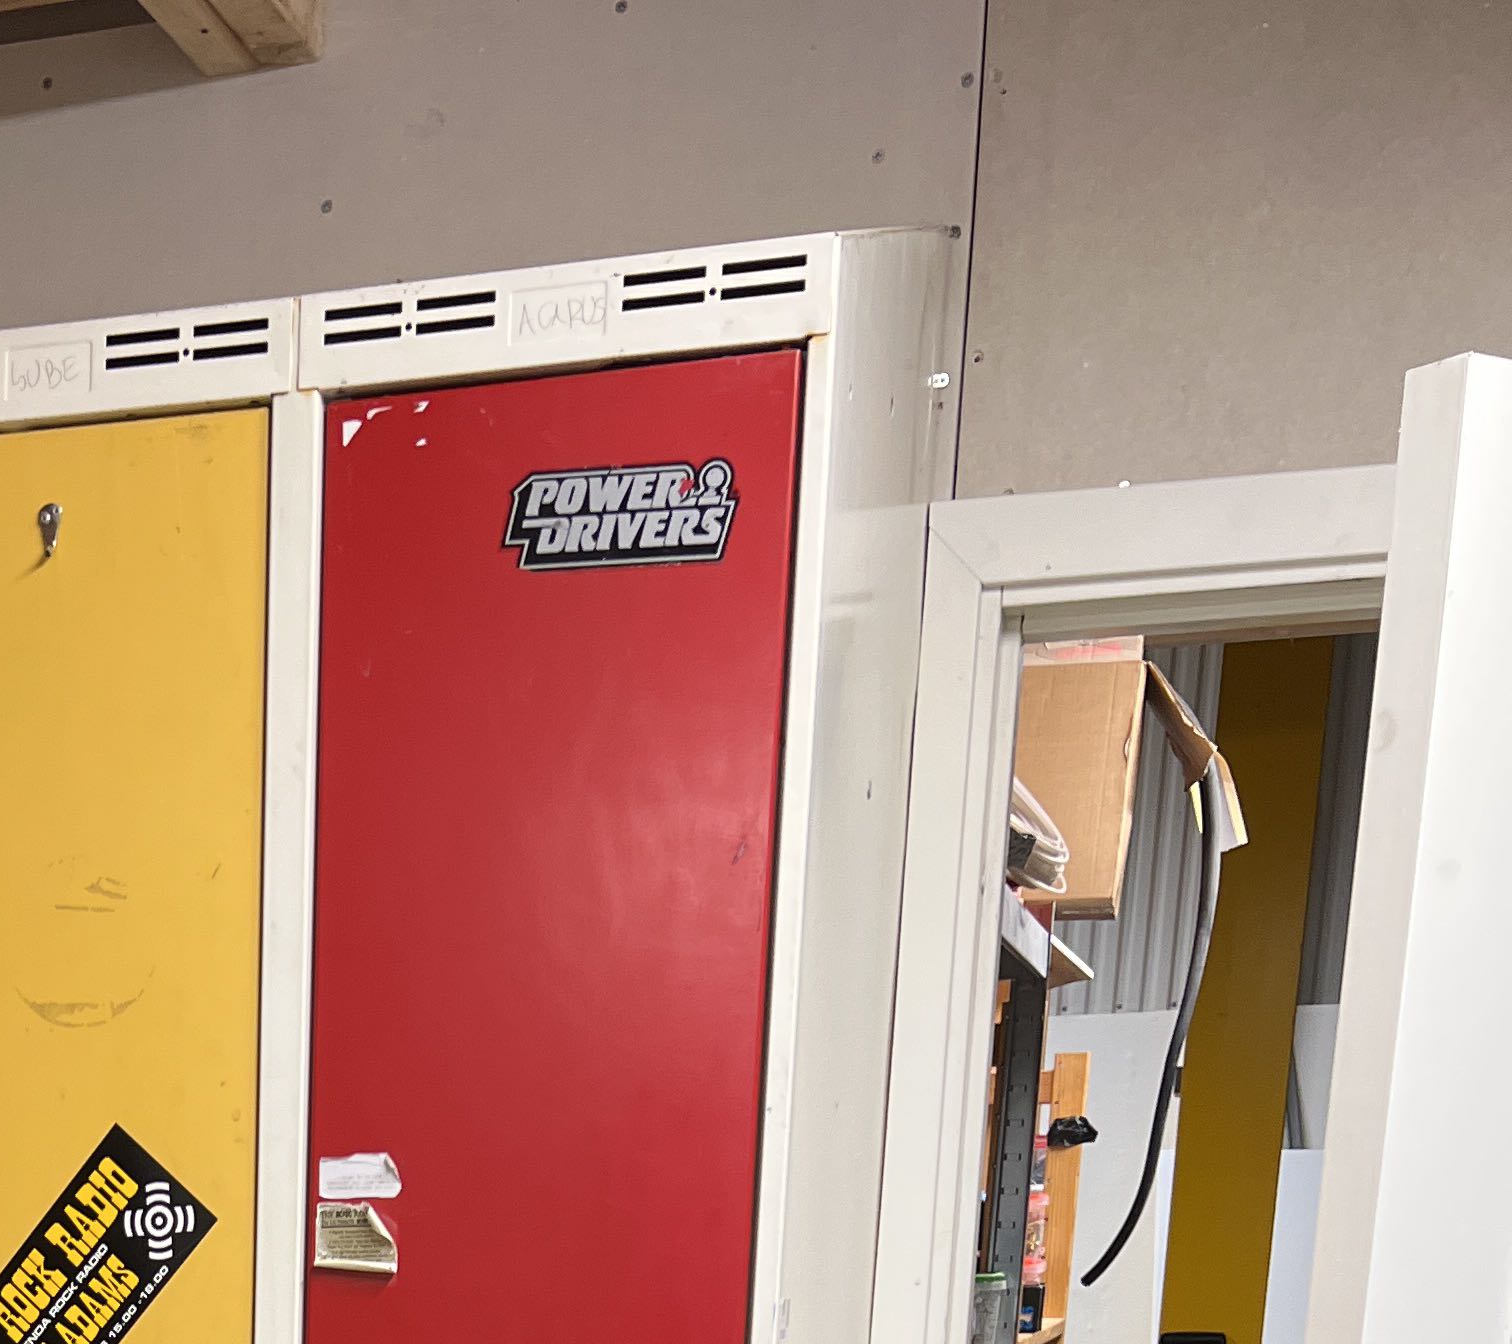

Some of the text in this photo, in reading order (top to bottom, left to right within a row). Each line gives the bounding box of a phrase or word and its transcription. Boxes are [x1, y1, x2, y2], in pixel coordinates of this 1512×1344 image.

[525, 471, 695, 517] POWER
[522, 508, 726, 554] DRIVERS
[44, 1157, 138, 1267] RADIO
[48, 1282, 78, 1318] ROCK
[75, 1243, 109, 1284] RADIO
